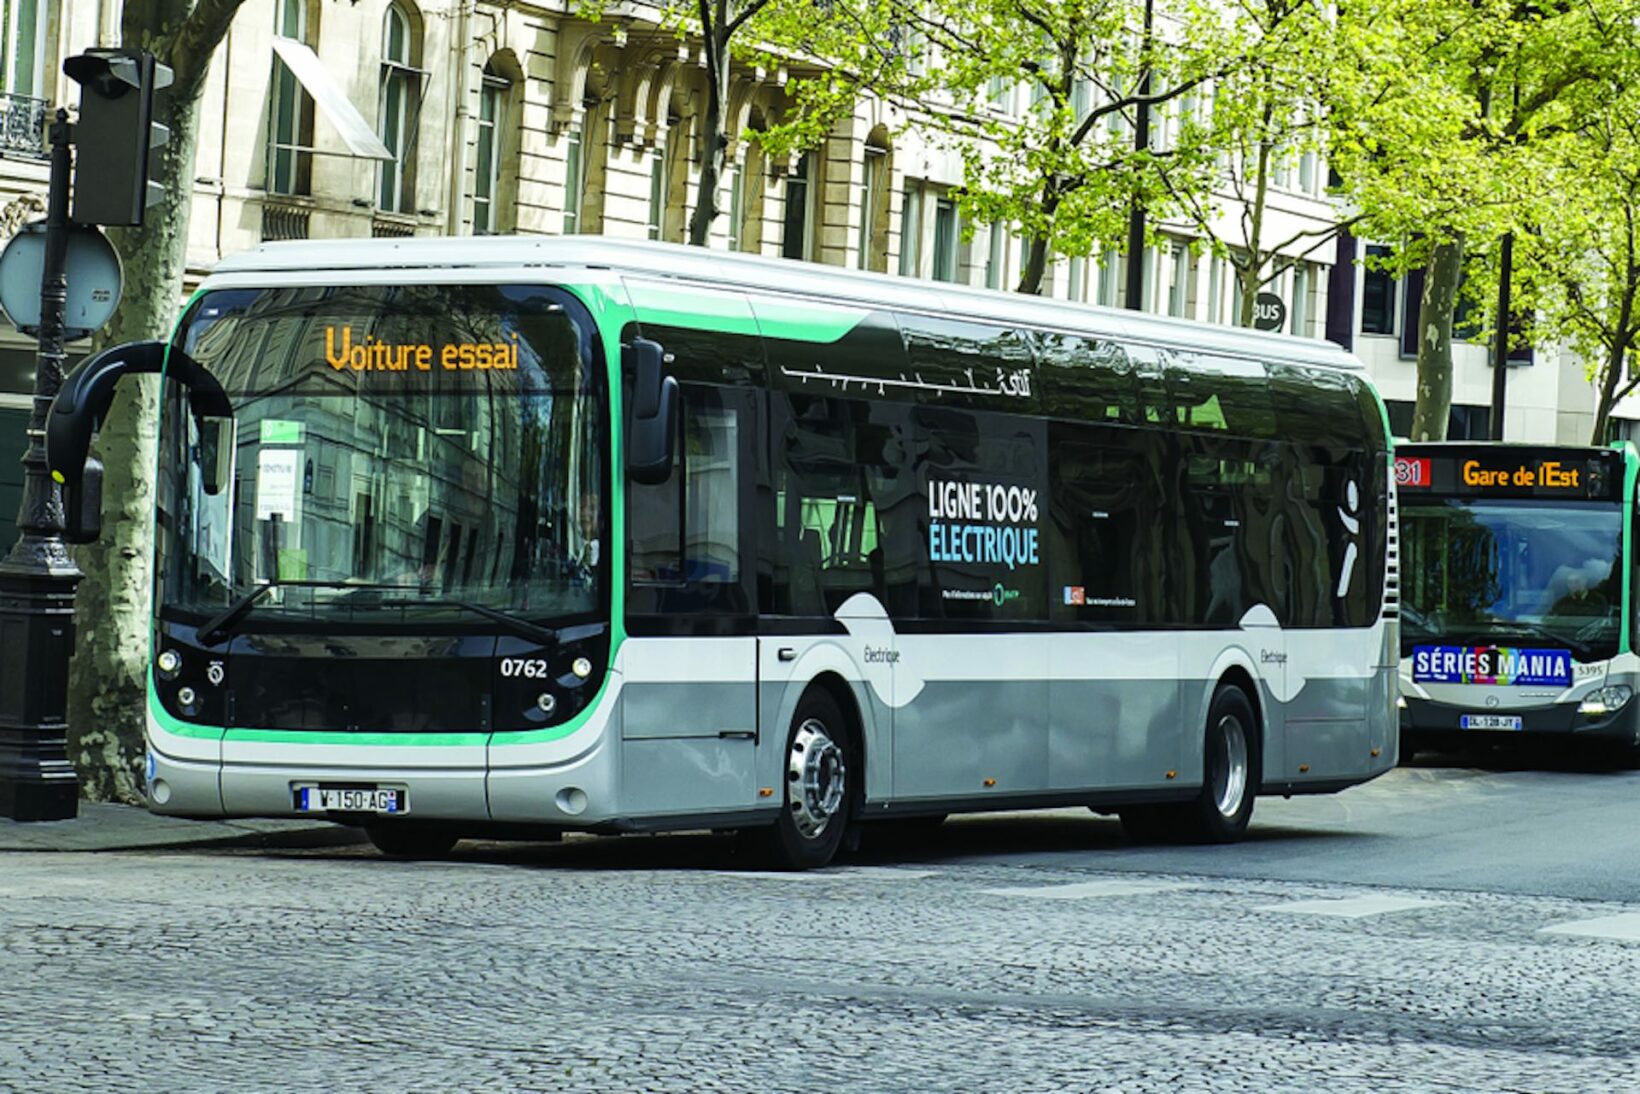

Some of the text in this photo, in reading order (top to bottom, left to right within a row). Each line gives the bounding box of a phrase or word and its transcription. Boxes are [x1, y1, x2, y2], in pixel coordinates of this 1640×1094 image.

[1253, 303, 1281, 320] BUS
[325, 326, 518, 371] Voiture essai
[1394, 459, 1422, 485] 31
[1463, 460, 1508, 486] Gare
[1513, 465, 1535, 486] de
[928, 480, 1039, 522] LIGNE 100%
[929, 519, 1040, 570] ÉLECTRIQUE
[500, 657, 548, 678] 0762
[1416, 647, 1567, 677] SÉRIES MANIA
[1578, 664, 1603, 676] 5395
